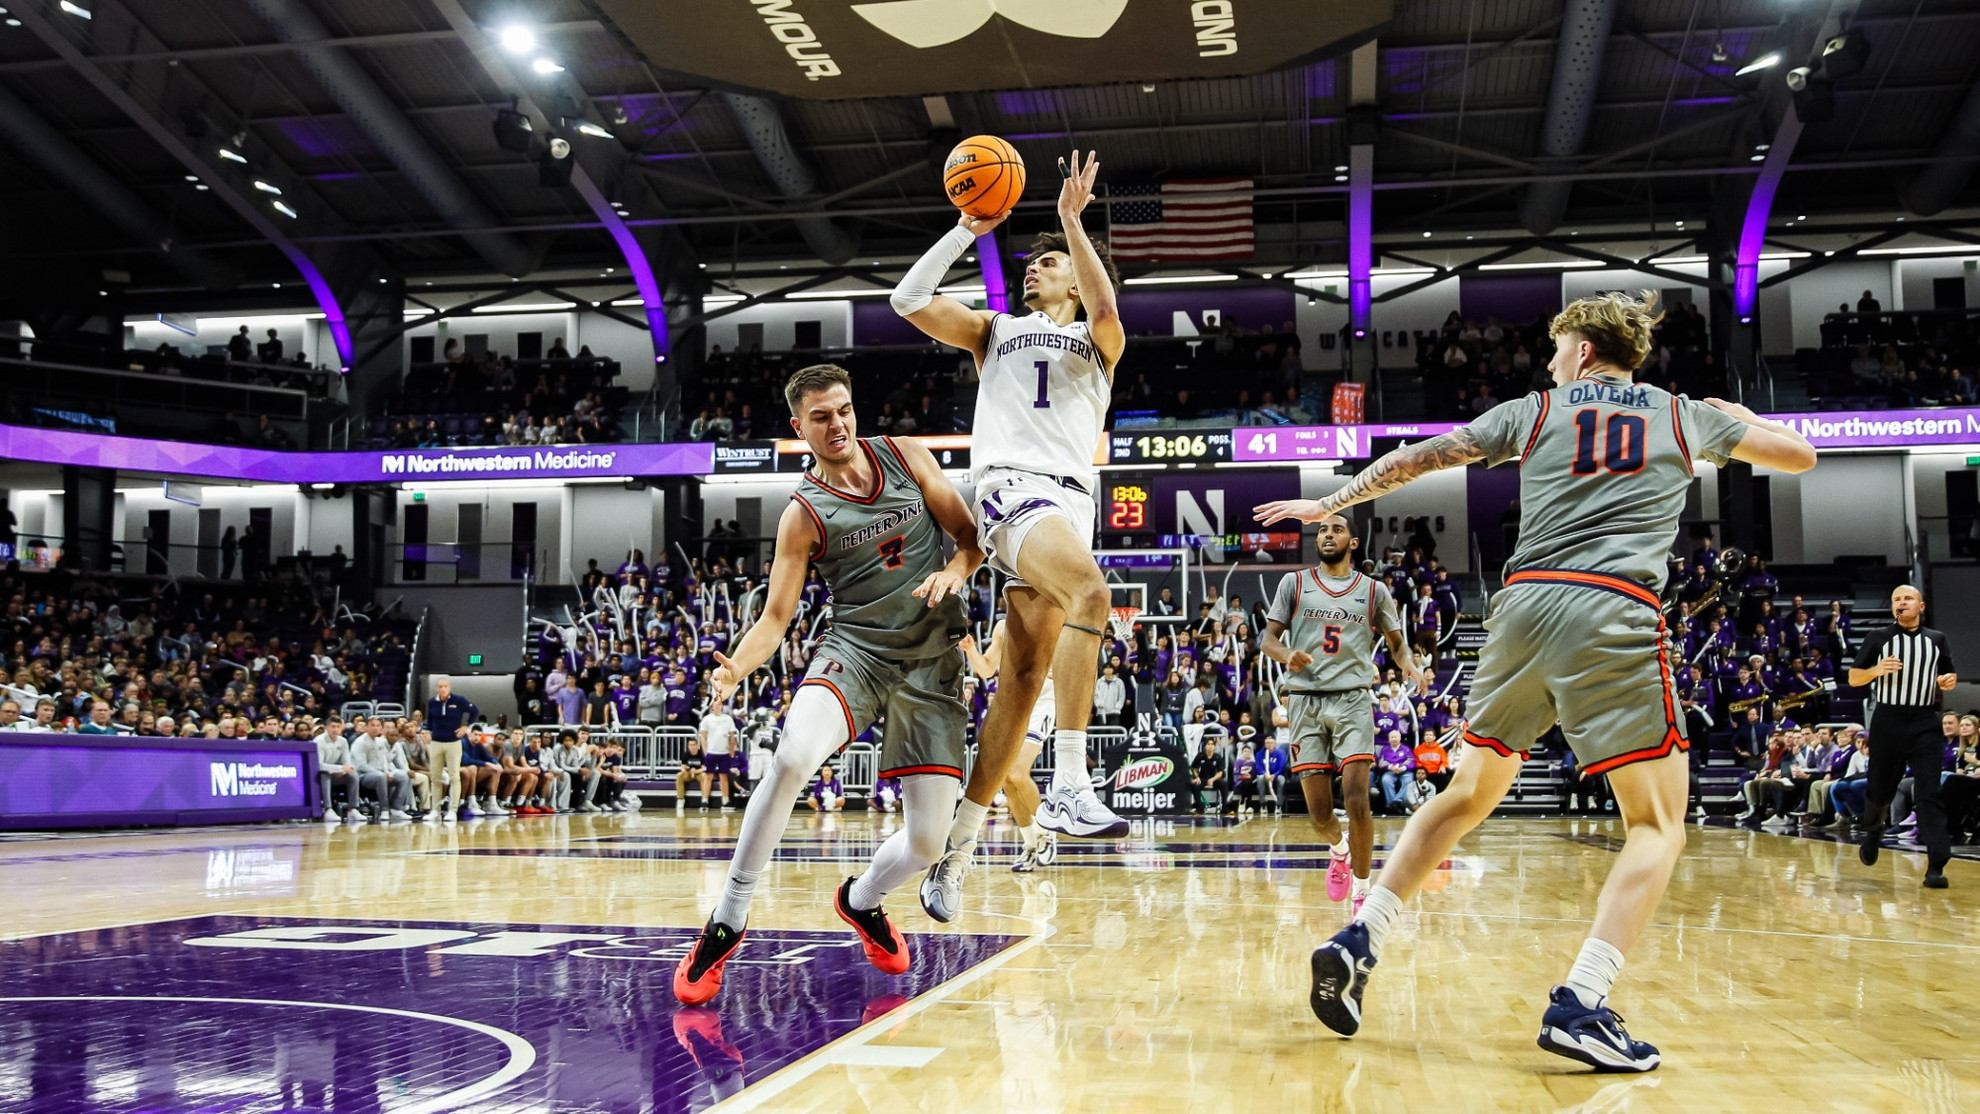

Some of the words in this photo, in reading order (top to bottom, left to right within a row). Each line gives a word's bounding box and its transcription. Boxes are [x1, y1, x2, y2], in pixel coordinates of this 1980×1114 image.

[948, 176, 976, 197] NCAA
[997, 332, 1093, 363] NORTHWESTERN
[1033, 361, 1050, 408] 1
[1386, 426, 1418, 435] STEALS
[1802, 416, 1961, 437] Northwestern
[1113, 437, 1133, 447] HALF
[1137, 435, 1207, 458] 13:06
[1248, 433, 1277, 454] 41
[1336, 427, 1358, 458] N
[1571, 408, 1648, 476] 10
[407, 454, 531, 472] Northwestern
[534, 451, 616, 469] Medicine
[942, 450, 952, 465] 8
[1114, 448, 1130, 458] 2ND
[1112, 486, 1147, 502] 13:06
[841, 499, 924, 551] PEPPERDINE
[1111, 502, 1144, 528] 23
[1176, 489, 1225, 563] N
[1302, 607, 1365, 626] PEPPERDINE
[1322, 624, 1342, 656] 5
[821, 658, 844, 675] P
[1138, 713, 1151, 732] N
[1116, 762, 1168, 789] LIBMAN
[1112, 787, 1176, 814] meijer
